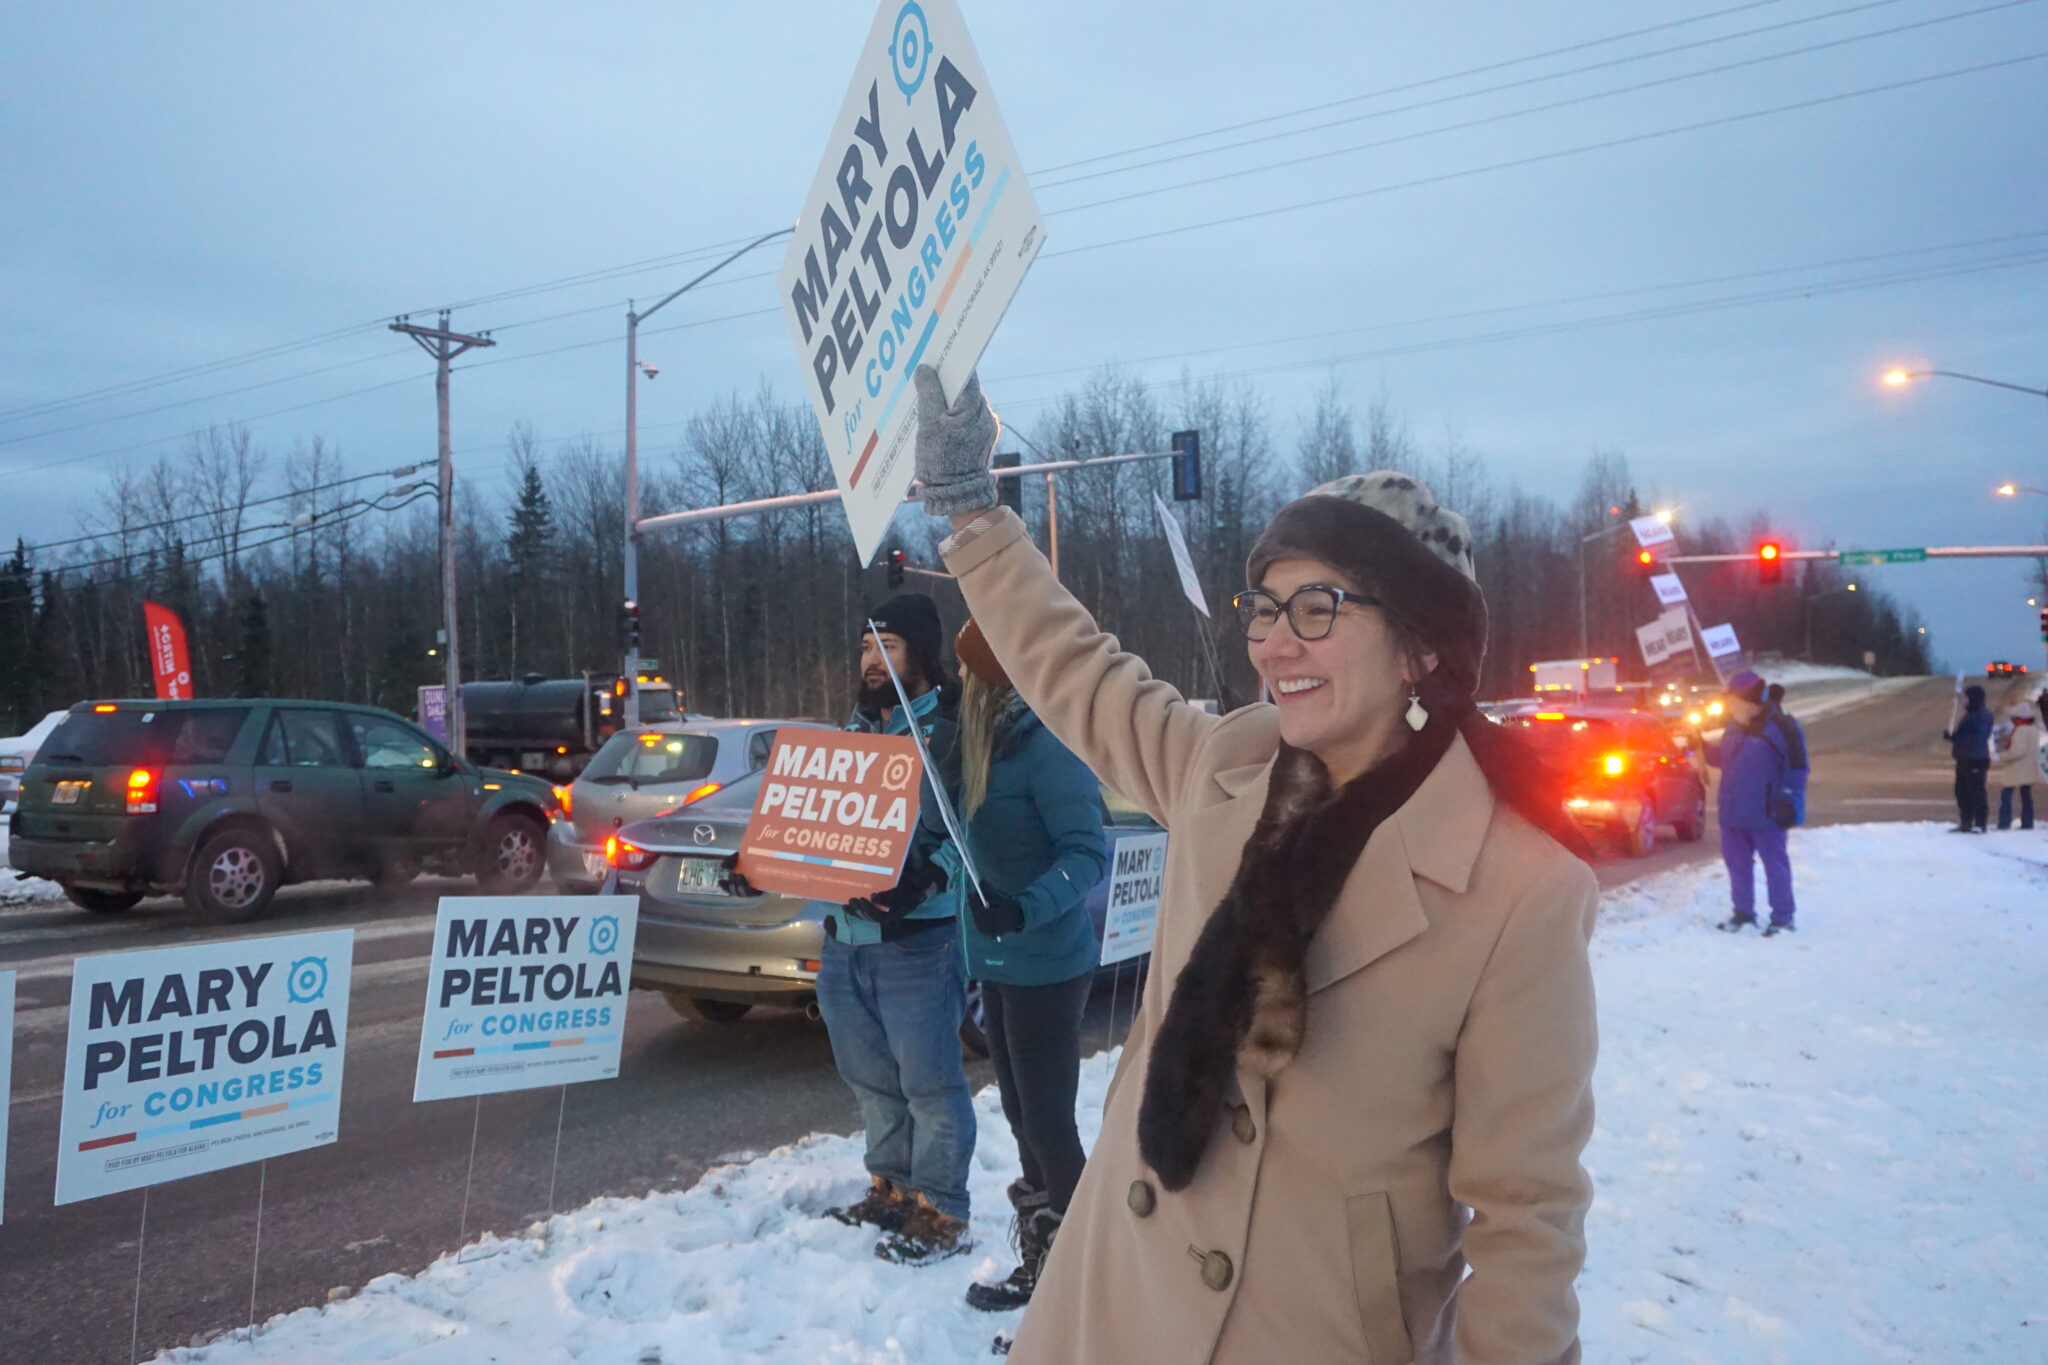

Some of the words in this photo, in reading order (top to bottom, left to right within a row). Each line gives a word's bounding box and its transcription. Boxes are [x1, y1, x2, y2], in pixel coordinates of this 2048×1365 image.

[791, 77, 888, 346] MARY
[813, 55, 977, 416] PELTOLA
[843, 398, 862, 456] for
[865, 139, 985, 398] CONGRESS
[772, 744, 880, 784] MARY
[760, 783, 906, 832] PELTOLA
[756, 824, 779, 841] for
[783, 827, 892, 858] CONGRESS
[1116, 848, 1152, 876] MARY
[1112, 876, 1160, 908] PELTOLA
[446, 917, 581, 958] MARY
[88, 962, 274, 1030] MARY
[440, 961, 622, 1008] PELTOLA
[442, 1019, 473, 1041] for
[481, 1007, 612, 1036] CONGRESS
[83, 1008, 337, 1091] PELTOLA
[90, 1100, 132, 1129] for
[143, 1063, 323, 1116] CONGRESS
